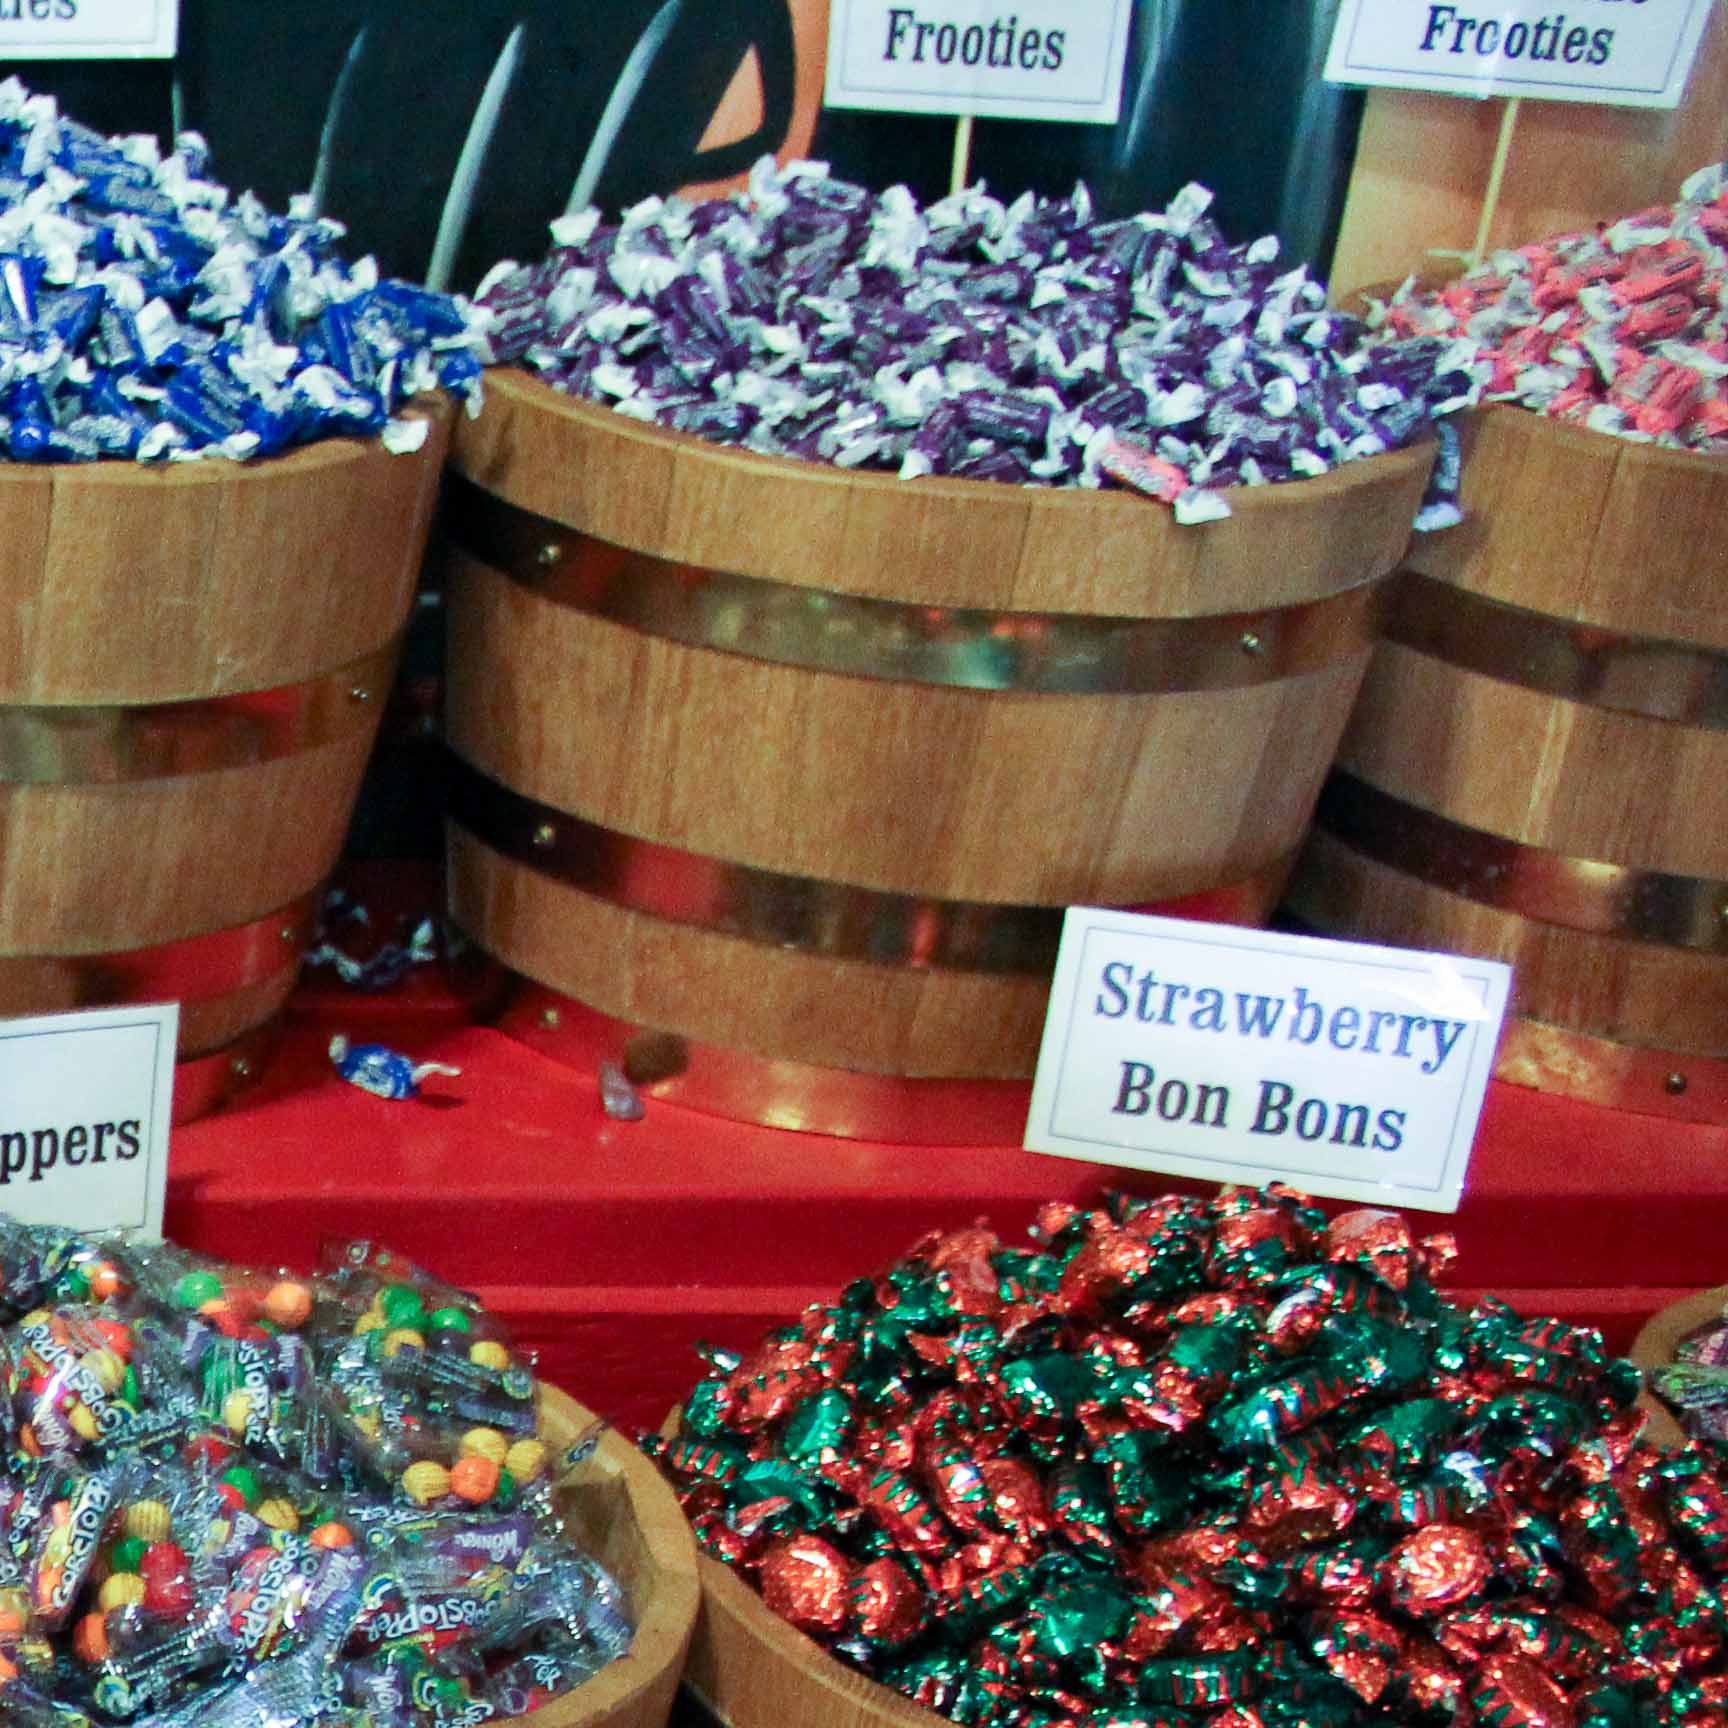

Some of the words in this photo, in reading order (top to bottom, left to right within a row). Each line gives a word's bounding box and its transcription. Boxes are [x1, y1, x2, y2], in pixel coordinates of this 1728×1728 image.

[882, 9, 1066, 70] Frooties
[1419, 5, 1615, 65] Frooties
[1093, 961, 1468, 1075] Strawberry
[1110, 1061, 1232, 1128] Bon
[1249, 1080, 1409, 1152] Bons
